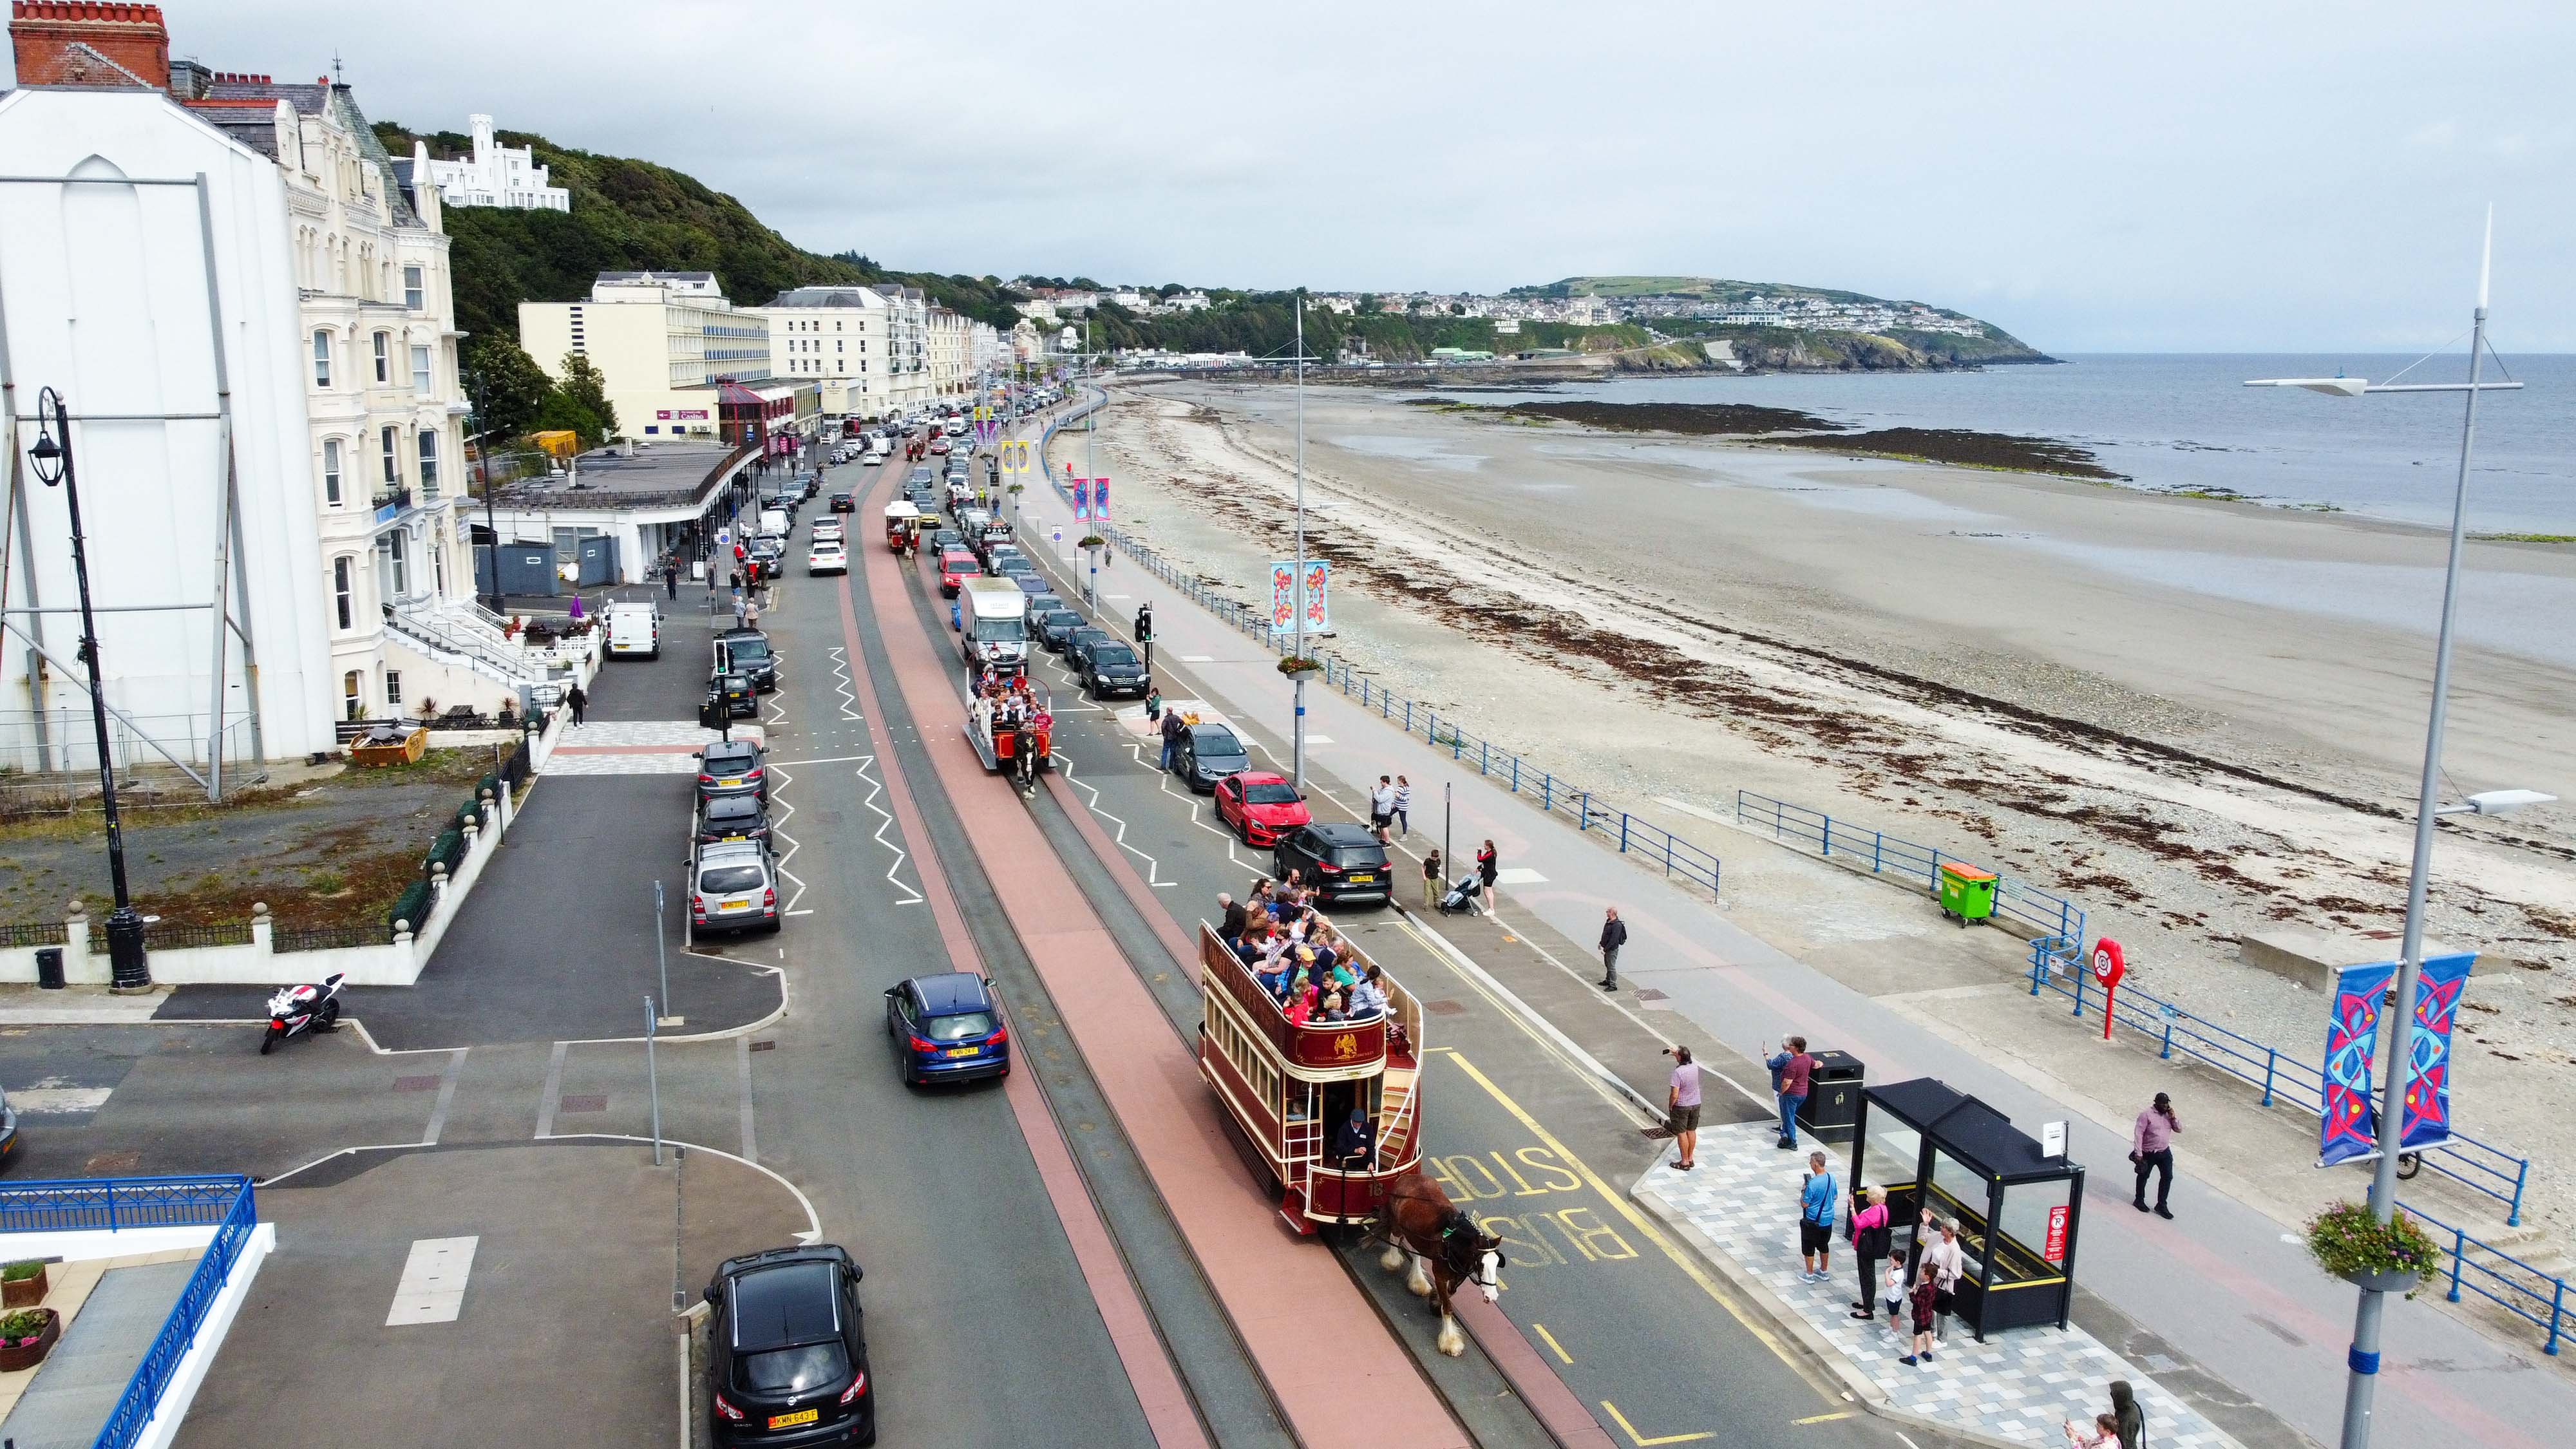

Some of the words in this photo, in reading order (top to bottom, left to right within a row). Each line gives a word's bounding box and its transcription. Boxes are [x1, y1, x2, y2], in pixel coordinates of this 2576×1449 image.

[1209, 945, 1236, 989] OKELL'S
[1238, 981, 1256, 1012] ALES
[1480, 1207, 1640, 1268] BUS
